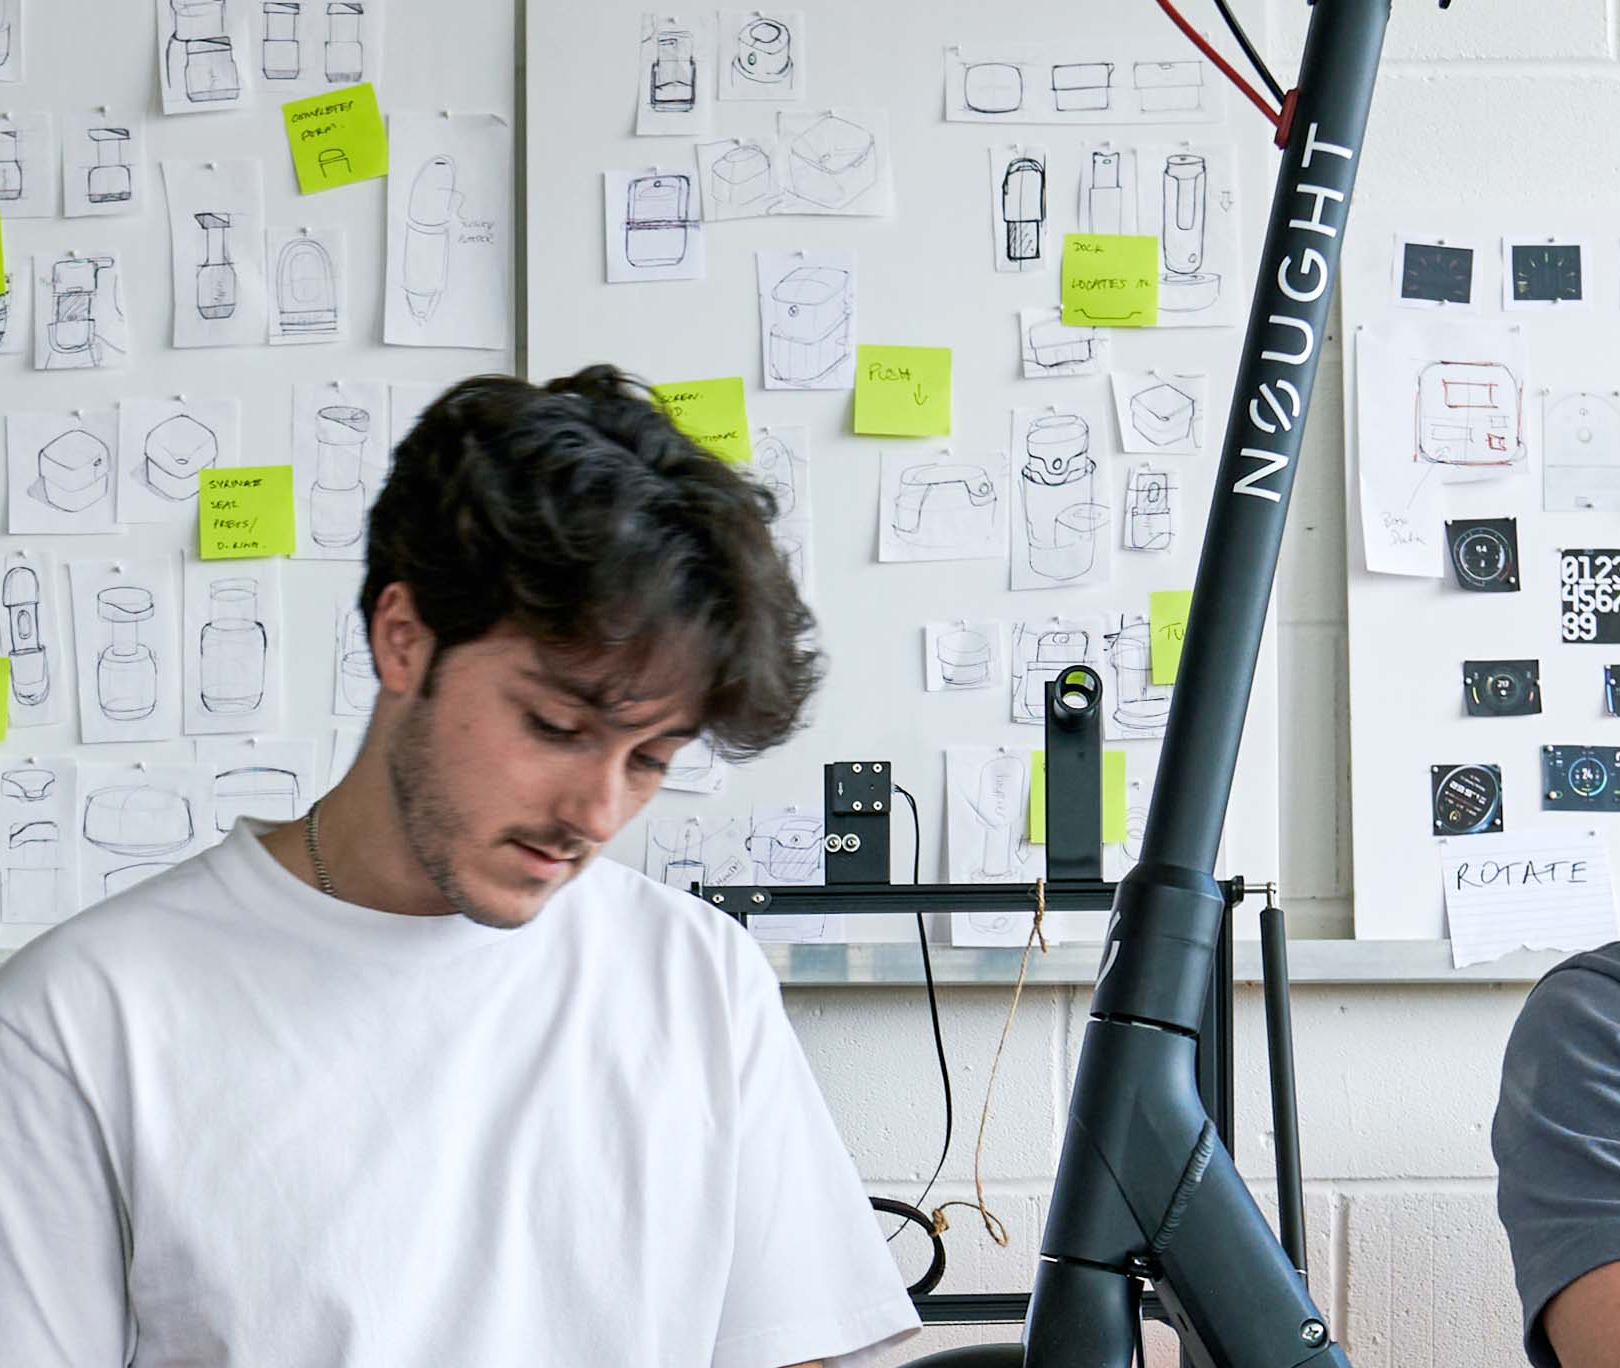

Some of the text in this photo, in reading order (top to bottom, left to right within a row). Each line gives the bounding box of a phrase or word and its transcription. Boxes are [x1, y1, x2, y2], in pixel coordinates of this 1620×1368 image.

[868, 361, 911, 381] PUSH
[1561, 611, 1598, 641] 89
[1456, 859, 1588, 891] ROTATE
